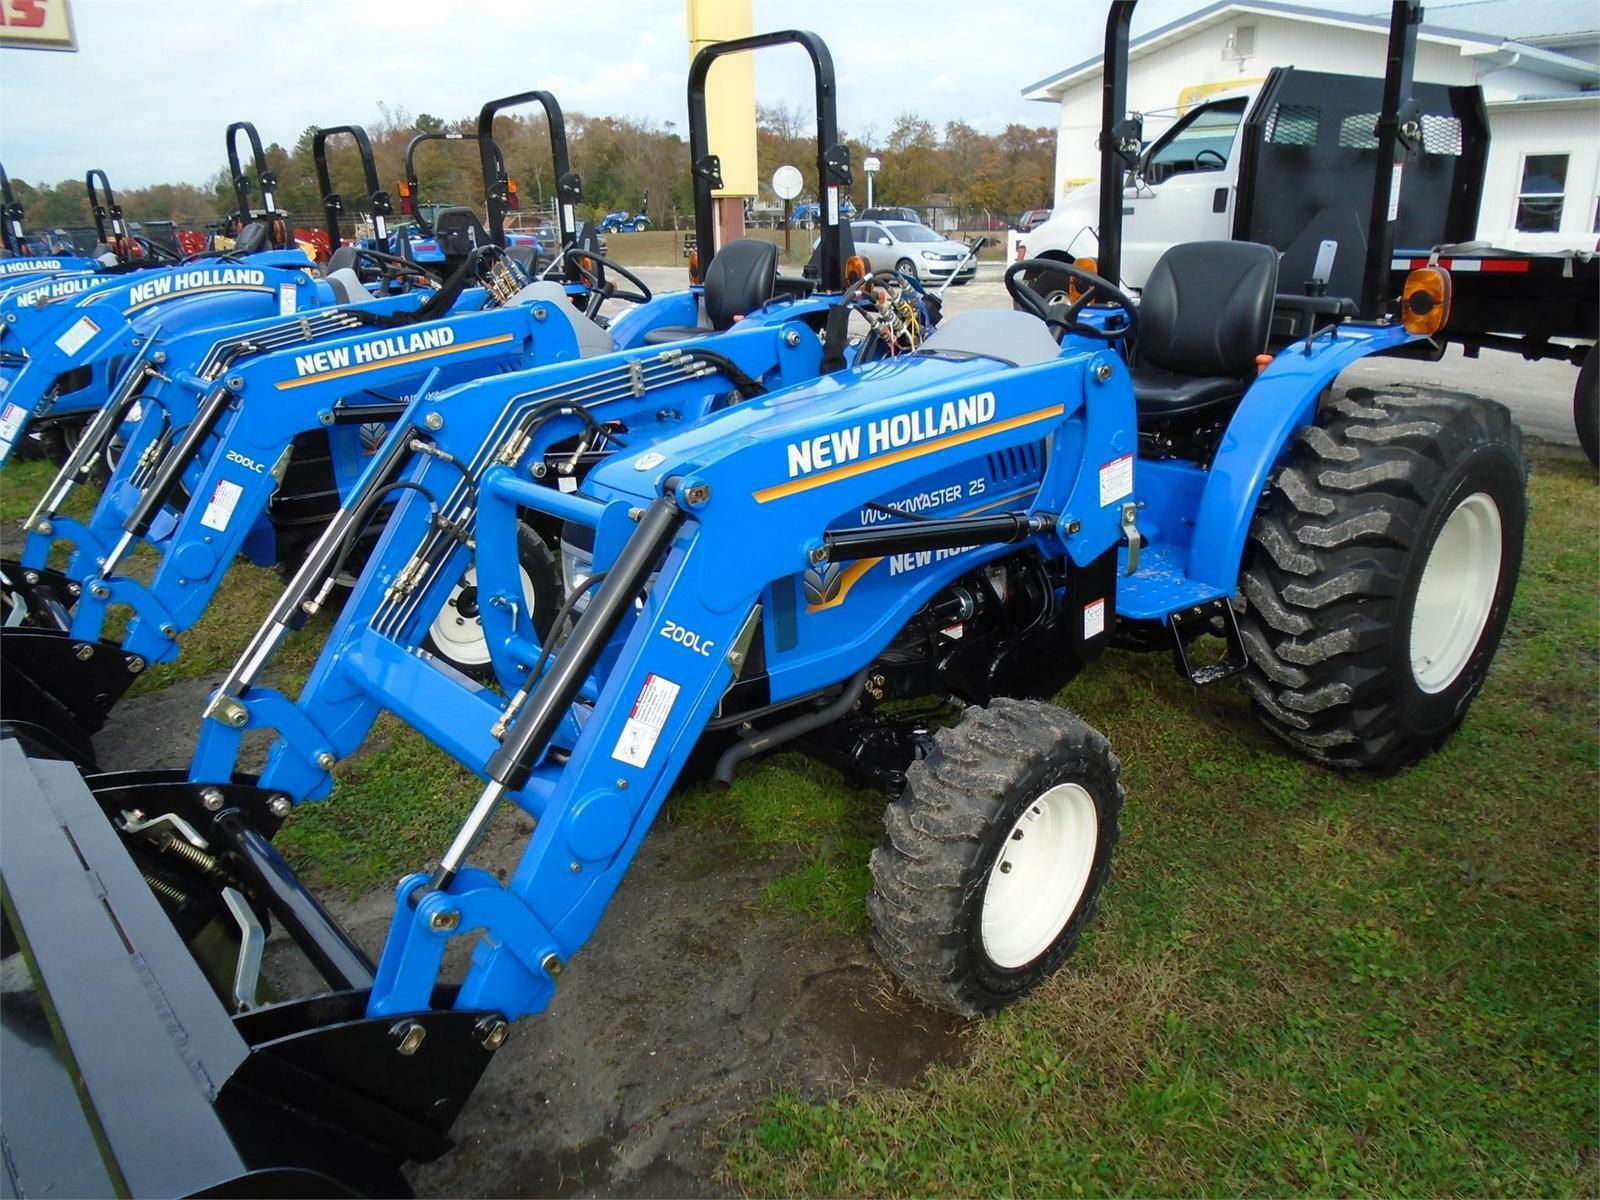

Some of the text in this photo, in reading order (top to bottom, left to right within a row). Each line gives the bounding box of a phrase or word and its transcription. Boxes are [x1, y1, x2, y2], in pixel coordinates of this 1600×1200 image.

[7, 260, 61, 273] HOLLAND
[16, 285, 50, 307] NEW
[130, 269, 265, 306] NEW HOLLAND
[295, 327, 455, 376] NEW HOLLAND
[787, 391, 996, 478] NEW HOLLAND
[225, 449, 265, 474] 200LC
[968, 477, 985, 496] 25
[890, 550, 932, 576] NEW
[660, 619, 714, 657] 200LC
